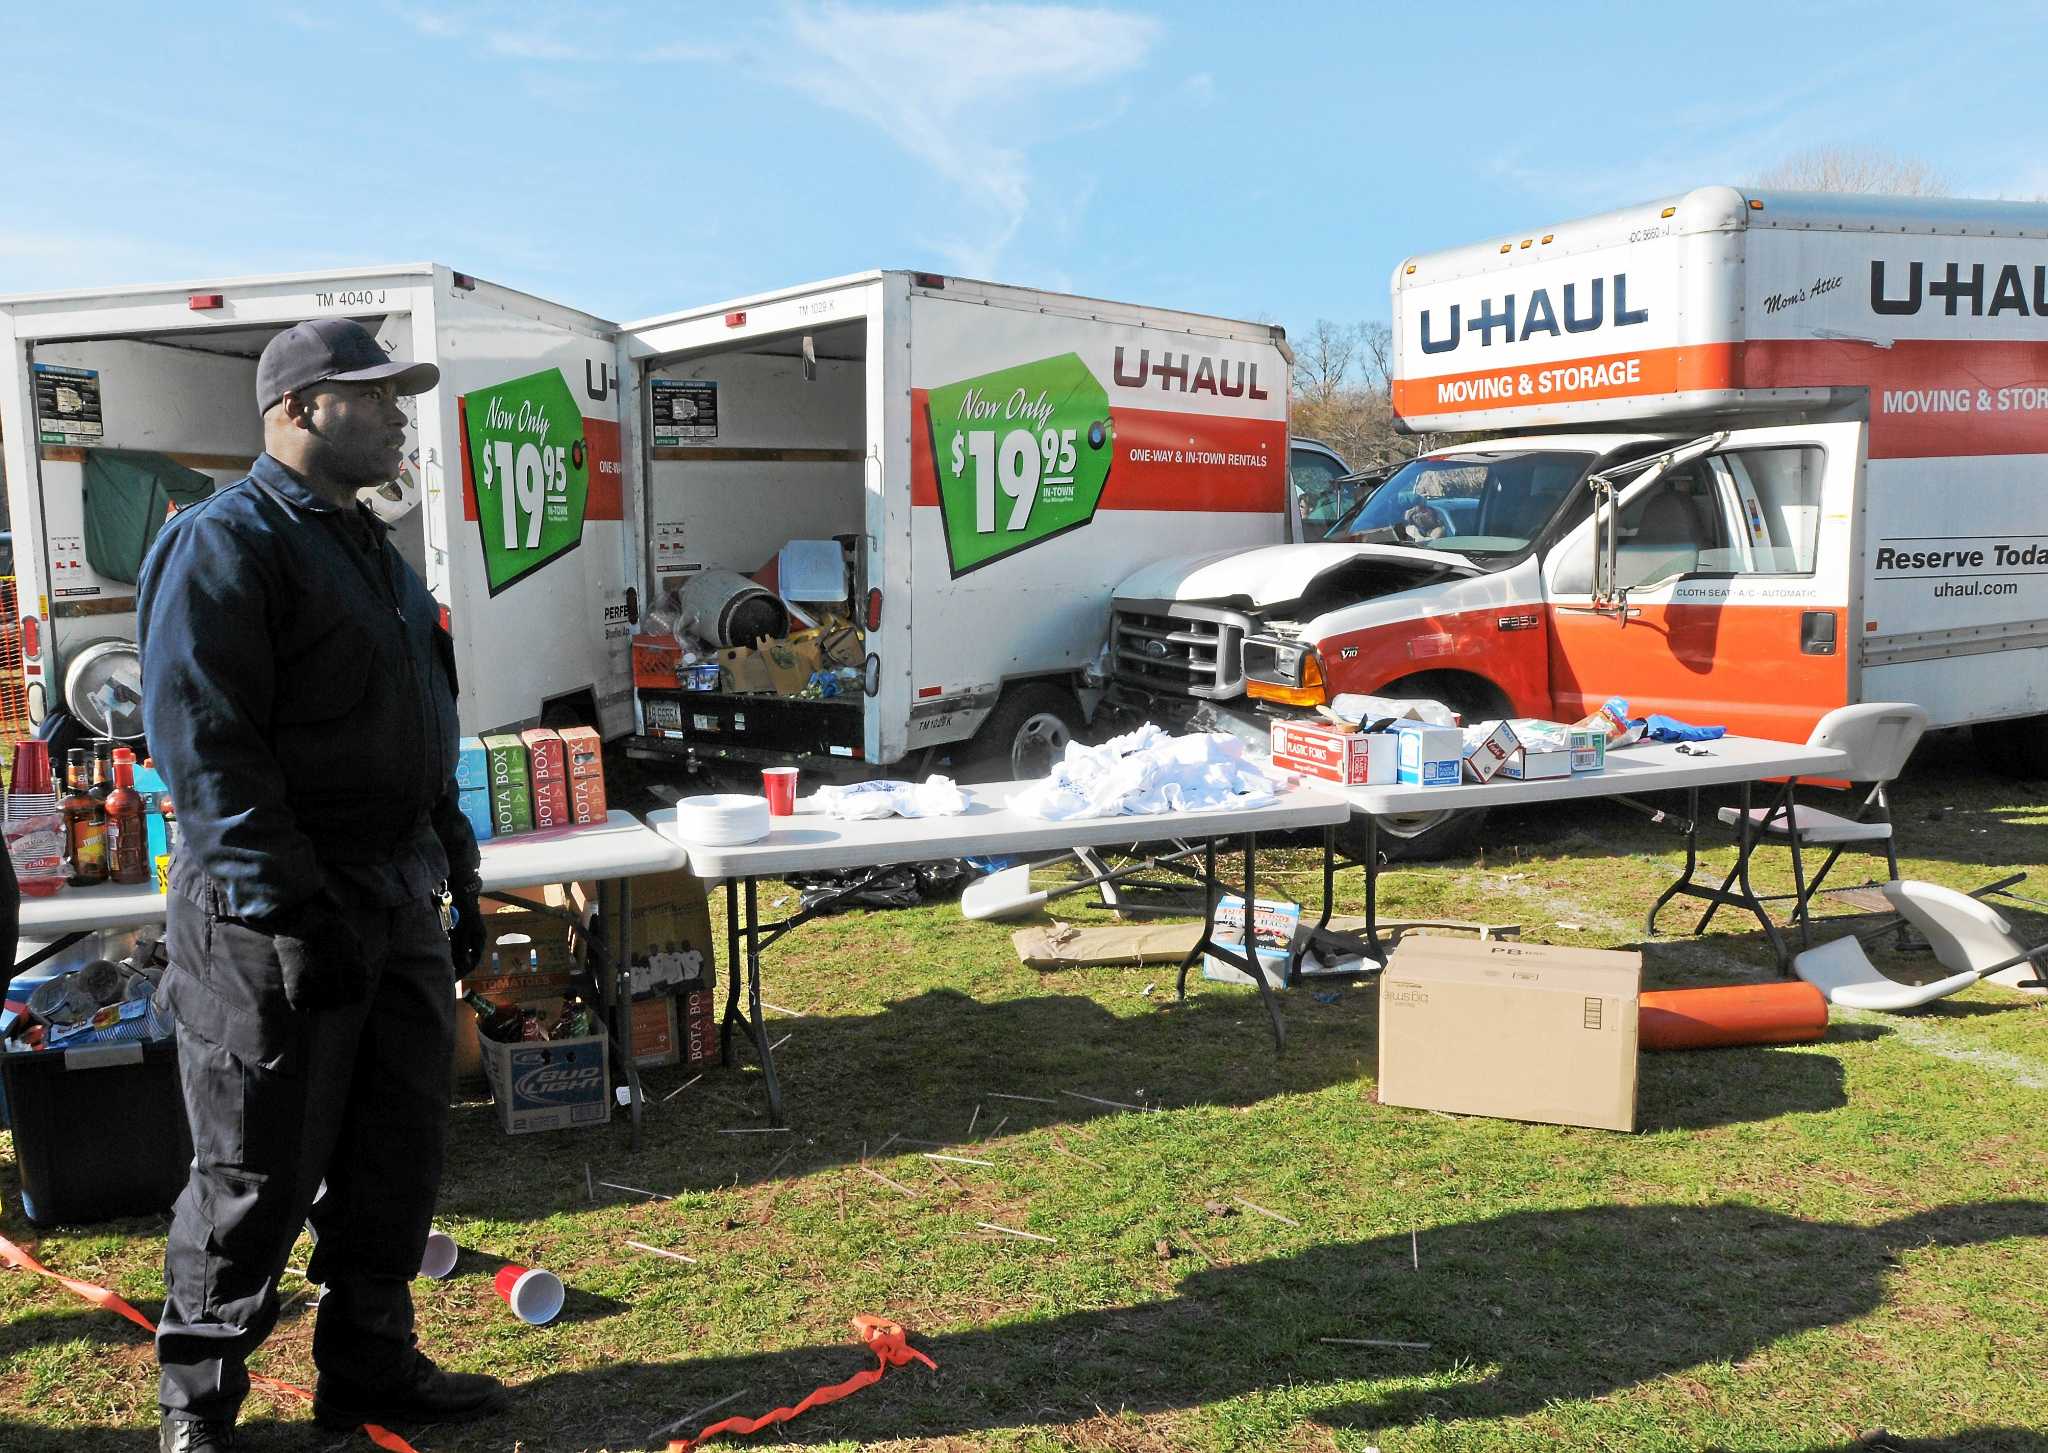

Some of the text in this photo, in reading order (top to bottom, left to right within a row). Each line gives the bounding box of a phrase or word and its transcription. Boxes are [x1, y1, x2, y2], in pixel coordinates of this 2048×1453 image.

[316, 290, 386, 307] TM 4040 J
[1764, 276, 1843, 315] Mom's Attic
[1870, 260, 2048, 317] U-HA
[1420, 273, 1649, 354] U-HAUL
[1113, 345, 1268, 400] U-HAUL
[1438, 359, 1641, 404] MOVING & STORAGE
[957, 387, 1055, 431] Now Only
[1883, 388, 2048, 414] MOVING & STOR
[485, 396, 551, 446] Now Only
[1130, 448, 1267, 467] ONE-WAY & IN-TOWN RENTALS
[1043, 486, 1074, 497] IN-TOWN
[1875, 544, 2048, 570] Reserve Toda
[1676, 588, 1706, 597] CLOTH
[1708, 588, 1731, 597] SEAT
[1762, 589, 1817, 598] AUTOMATIC
[1934, 581, 2018, 598] uhaul.com
[604, 605, 629, 620] PERFE
[1287, 742, 1327, 760] PLASTIC FORKS
[493, 751, 513, 832] BOTA BOX
[534, 745, 553, 827] BOTA BOX
[571, 740, 591, 824] BOTA BOX
[689, 990, 703, 1061] BOTA BO
[525, 1076, 602, 1095] LIGHT
[537, 1067, 600, 1082] BUD
